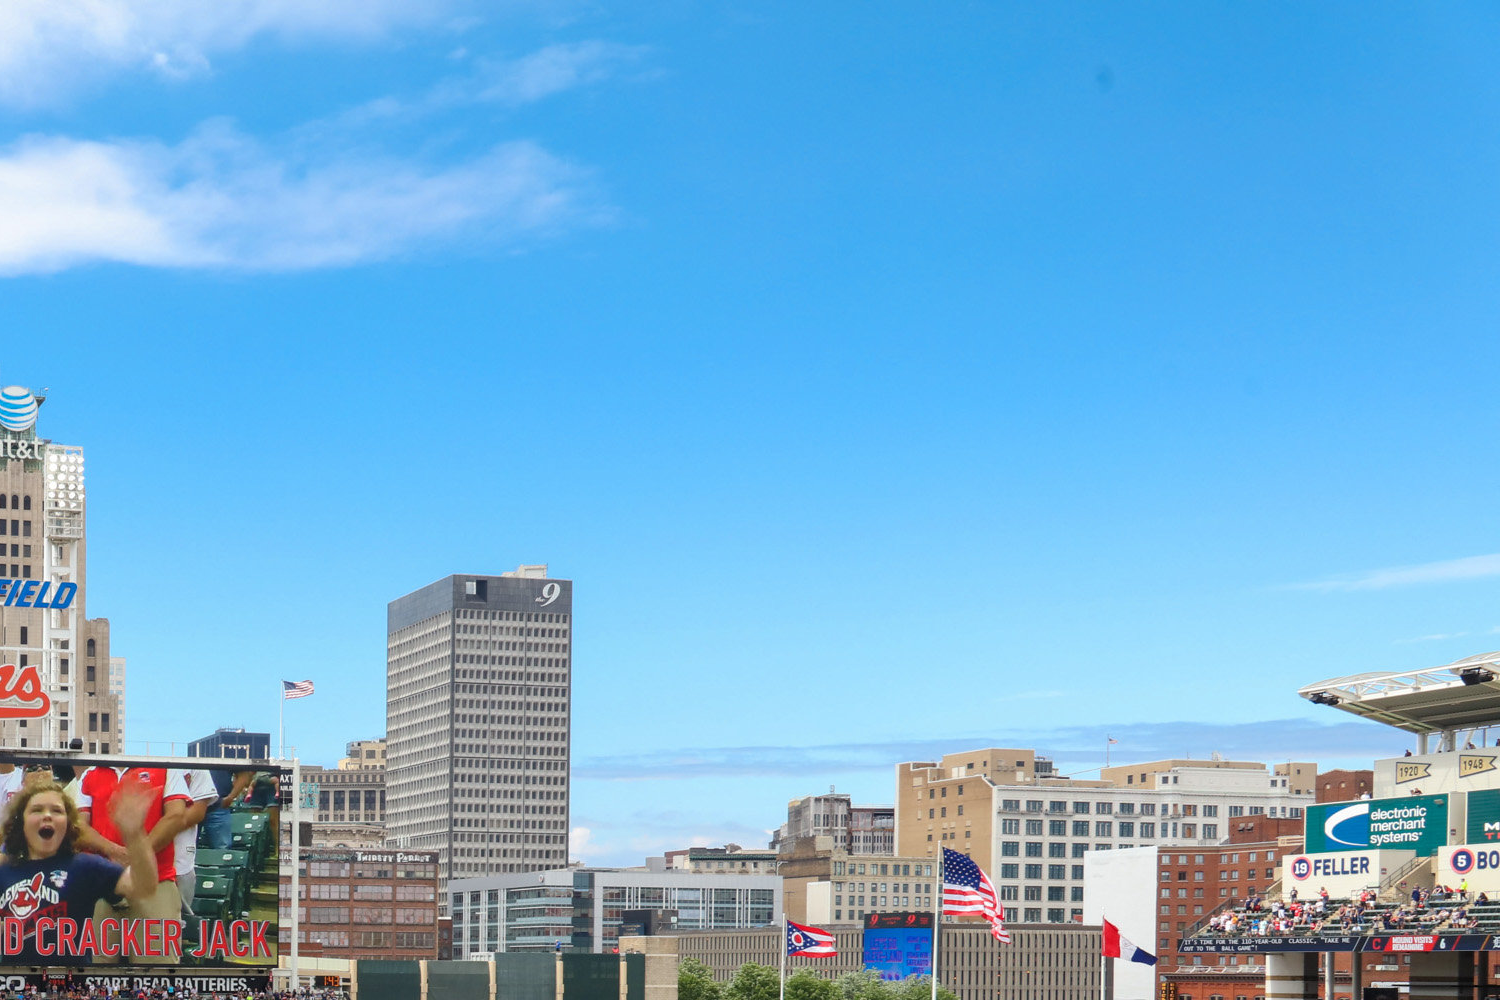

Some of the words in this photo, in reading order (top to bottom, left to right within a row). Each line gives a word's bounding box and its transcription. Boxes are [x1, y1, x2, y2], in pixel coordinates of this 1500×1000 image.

[540, 583, 560, 607] 9
[1400, 766, 1418, 777] 1920
[1463, 759, 1483, 770] 1948
[1370, 805, 1427, 821] electronic
[1370, 818, 1426, 832] merchant
[1370, 830, 1419, 844] systems
[356, 851, 394, 862] THIRSTY
[397, 852, 431, 863] PARROT
[1457, 855, 1467, 867] 5
[1294, 862, 1308, 874] 19
[1314, 857, 1370, 876] FELLER
[35, 917, 183, 957] CRACKER
[191, 918, 272, 958] JACK
[1372, 938, 1381, 949] C
[1392, 936, 1413, 944] MOUND
[1440, 939, 1446, 949] 6
[86, 976, 130, 990] START
[134, 976, 170, 991] DEAD
[175, 977, 251, 992] BATTERIES.
